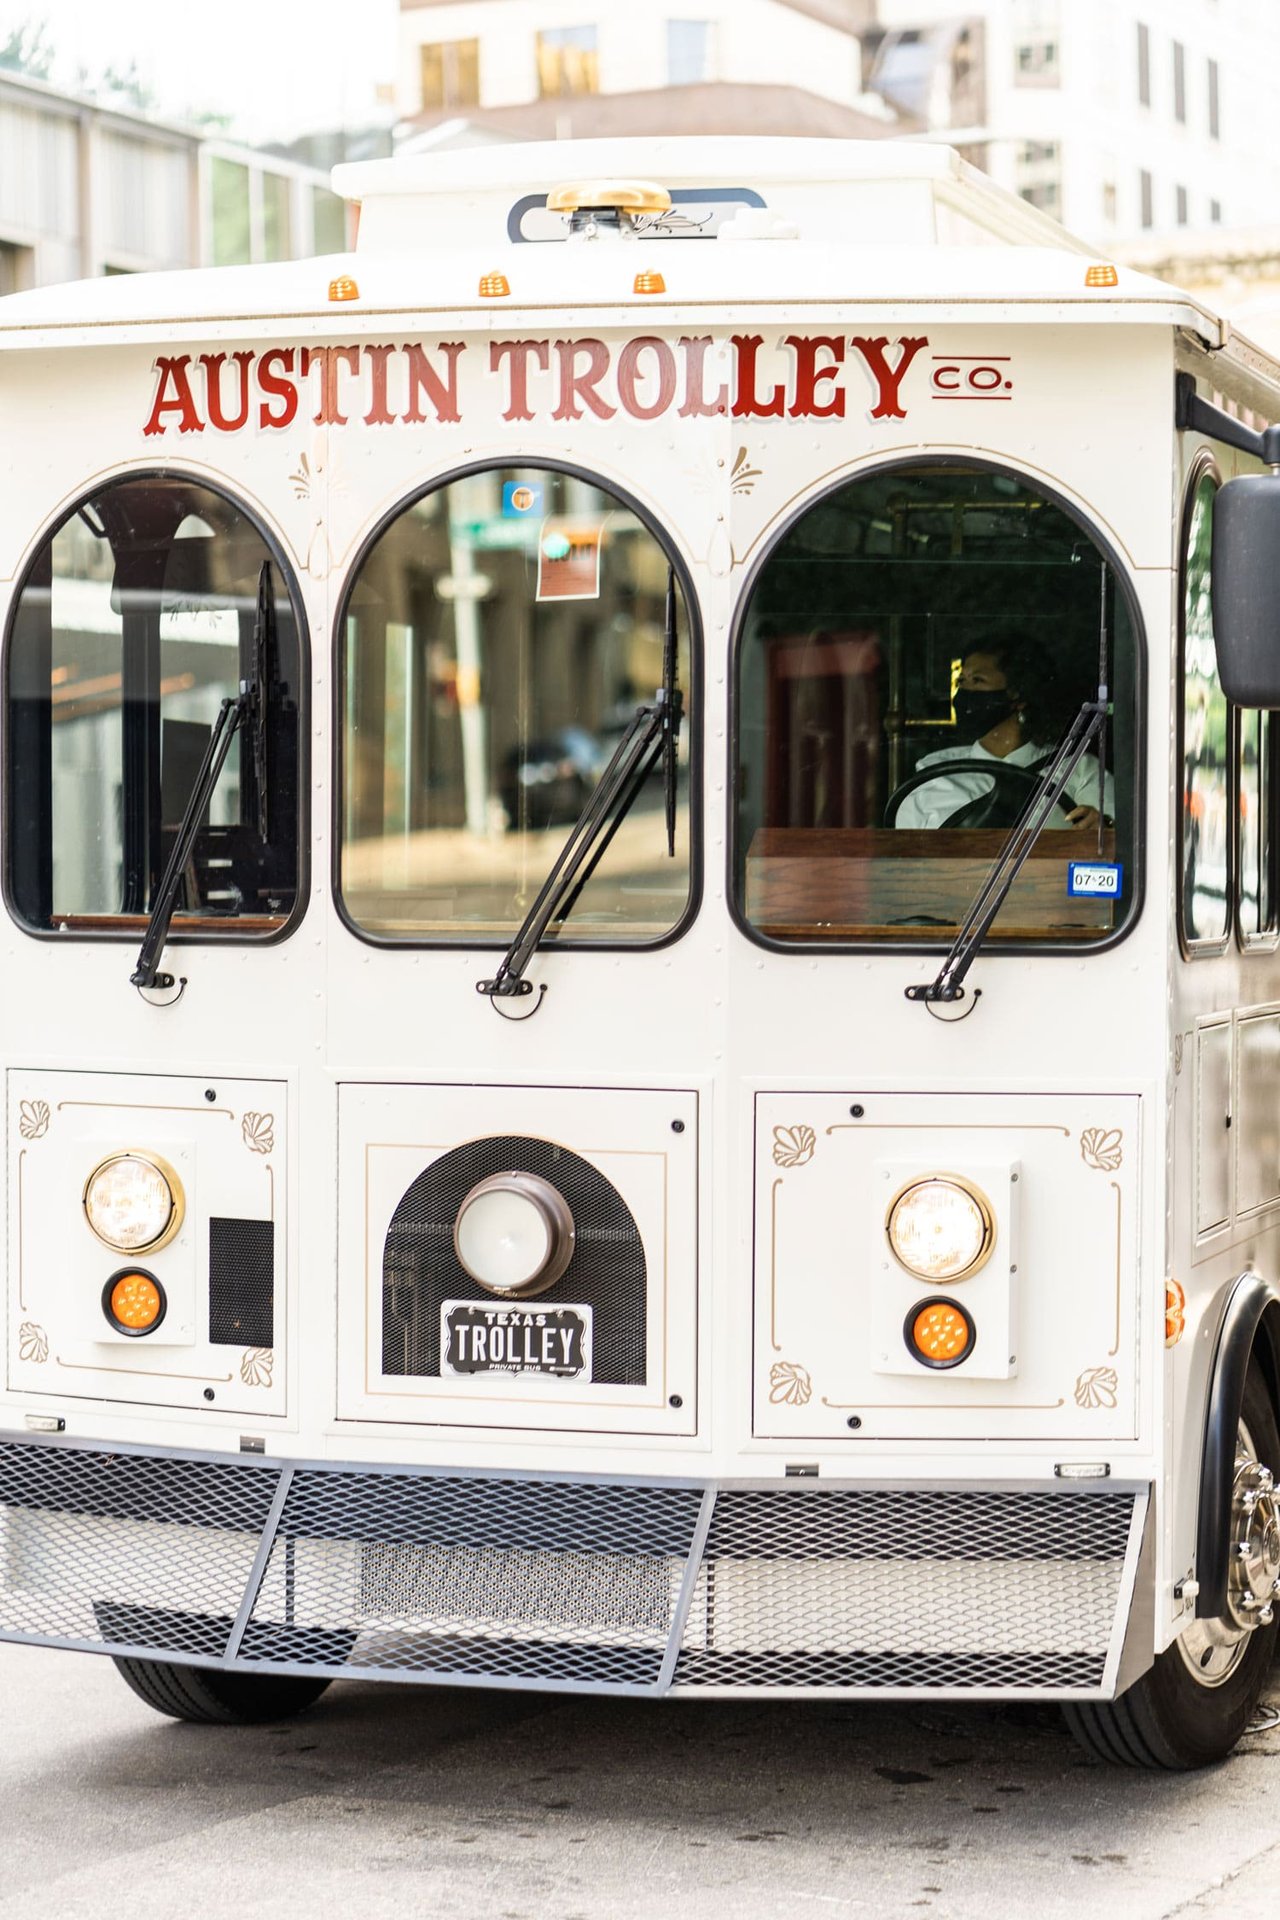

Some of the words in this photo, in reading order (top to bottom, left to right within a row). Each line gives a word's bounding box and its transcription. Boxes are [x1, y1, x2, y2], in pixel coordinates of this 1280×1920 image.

[142, 341, 467, 437] AUSTIN
[490, 334, 929, 420] TROLLEY
[932, 365, 1013, 391] CO.
[485, 1313, 546, 1326] TEXAS
[455, 1324, 574, 1365] TROLLEY
[489, 1363, 521, 1371] PRIVATE
